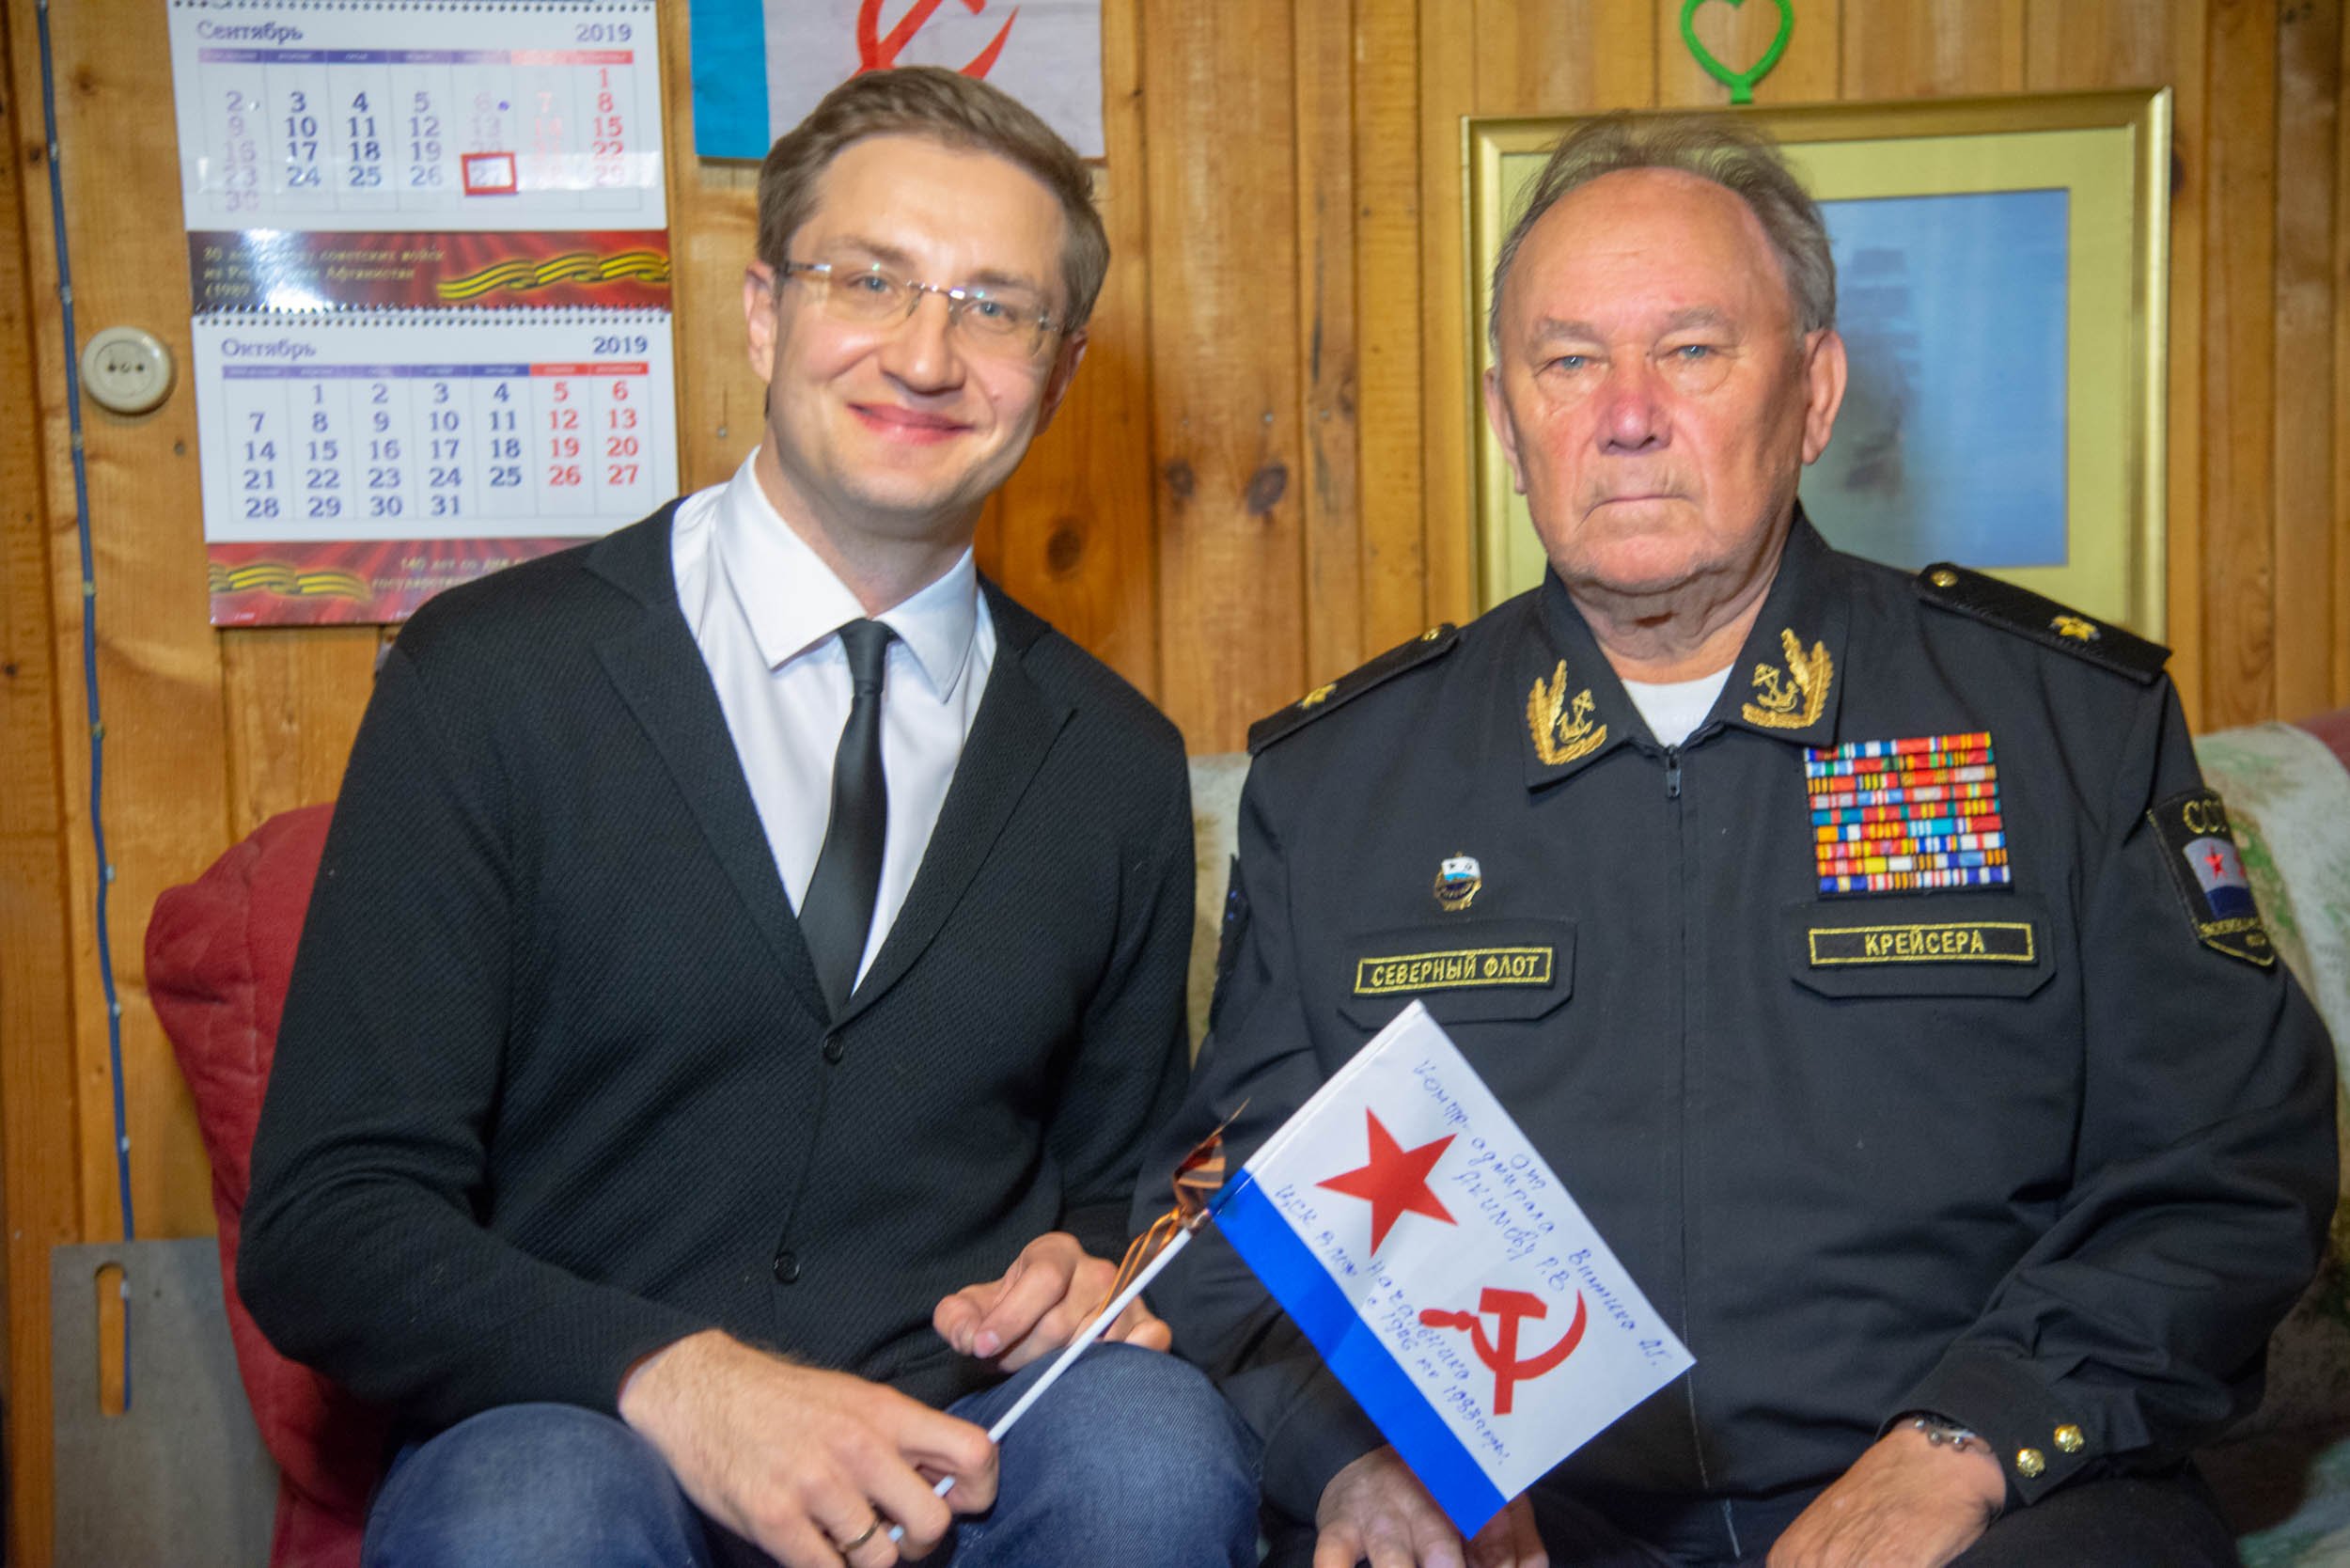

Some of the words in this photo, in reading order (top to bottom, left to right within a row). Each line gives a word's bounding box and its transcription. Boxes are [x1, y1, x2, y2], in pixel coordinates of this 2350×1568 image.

[197, 20, 304, 45] Сентябрь
[575, 24, 632, 42] 2019
[598, 68, 609, 88] 1
[226, 91, 243, 112] 2
[290, 91, 306, 113] 3
[352, 91, 369, 112] 4
[415, 91, 431, 112] 5
[598, 91, 614, 113] 8
[228, 115, 244, 137] 9
[286, 116, 318, 137] 10
[348, 116, 375, 137] 11
[409, 116, 440, 137] 12
[593, 116, 623, 137] 15
[225, 140, 256, 163] 16
[287, 140, 318, 162] 17
[349, 140, 381, 162] 18
[411, 140, 442, 162] 19
[592, 140, 624, 161] 22
[287, 165, 321, 186] 24
[349, 165, 382, 187] 25
[410, 165, 444, 186] 26
[222, 338, 317, 360] Октябрь
[592, 336, 648, 354] 2019
[313, 384, 323, 404] 1
[371, 383, 388, 404] 2
[433, 383, 449, 404] 3
[494, 383, 509, 402] 4
[554, 382, 569, 401] 5
[612, 381, 628, 401] 6
[249, 411, 265, 432] 7
[313, 411, 328, 432] 8
[373, 411, 389, 432] 9
[430, 410, 460, 431] 10
[490, 410, 516, 431] 11
[549, 409, 579, 430] 12
[609, 408, 637, 430] 13
[245, 440, 276, 462] 14
[308, 440, 338, 462] 15
[369, 439, 400, 461] 16
[431, 439, 460, 460] 17
[492, 438, 521, 459] 18
[551, 437, 580, 458] 19
[607, 436, 638, 457] 20
[244, 469, 274, 490] 21
[306, 468, 340, 489] 22
[368, 468, 401, 489] 23
[430, 466, 462, 488] 24
[490, 466, 522, 487] 25
[549, 465, 581, 486] 26
[608, 464, 639, 485] 27
[245, 497, 280, 519] 28
[308, 496, 341, 518] 29
[369, 495, 402, 517] 30
[431, 494, 461, 516] 31
[1864, 927, 1986, 956] КРЕЙСЕРА
[1370, 952, 1477, 987] СЕВЕРНЫЙ
[1482, 954, 1541, 978] ФЛОТ
